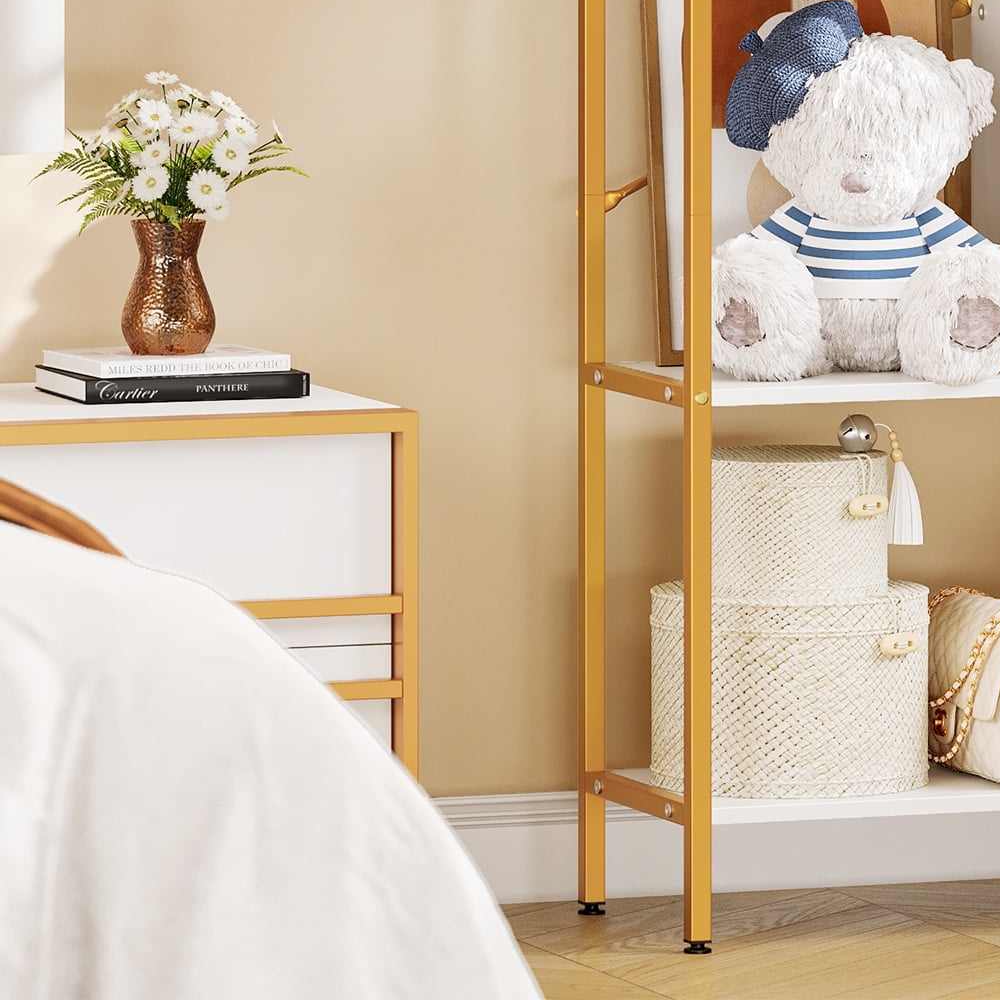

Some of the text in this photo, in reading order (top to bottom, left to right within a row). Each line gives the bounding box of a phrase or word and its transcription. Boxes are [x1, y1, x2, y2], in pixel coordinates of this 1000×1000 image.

[108, 359, 282, 375] MILES REDD THE BOOK OF CHIC
[95, 380, 159, 401] Cartier
[195, 383, 249, 394] PANTHERE
